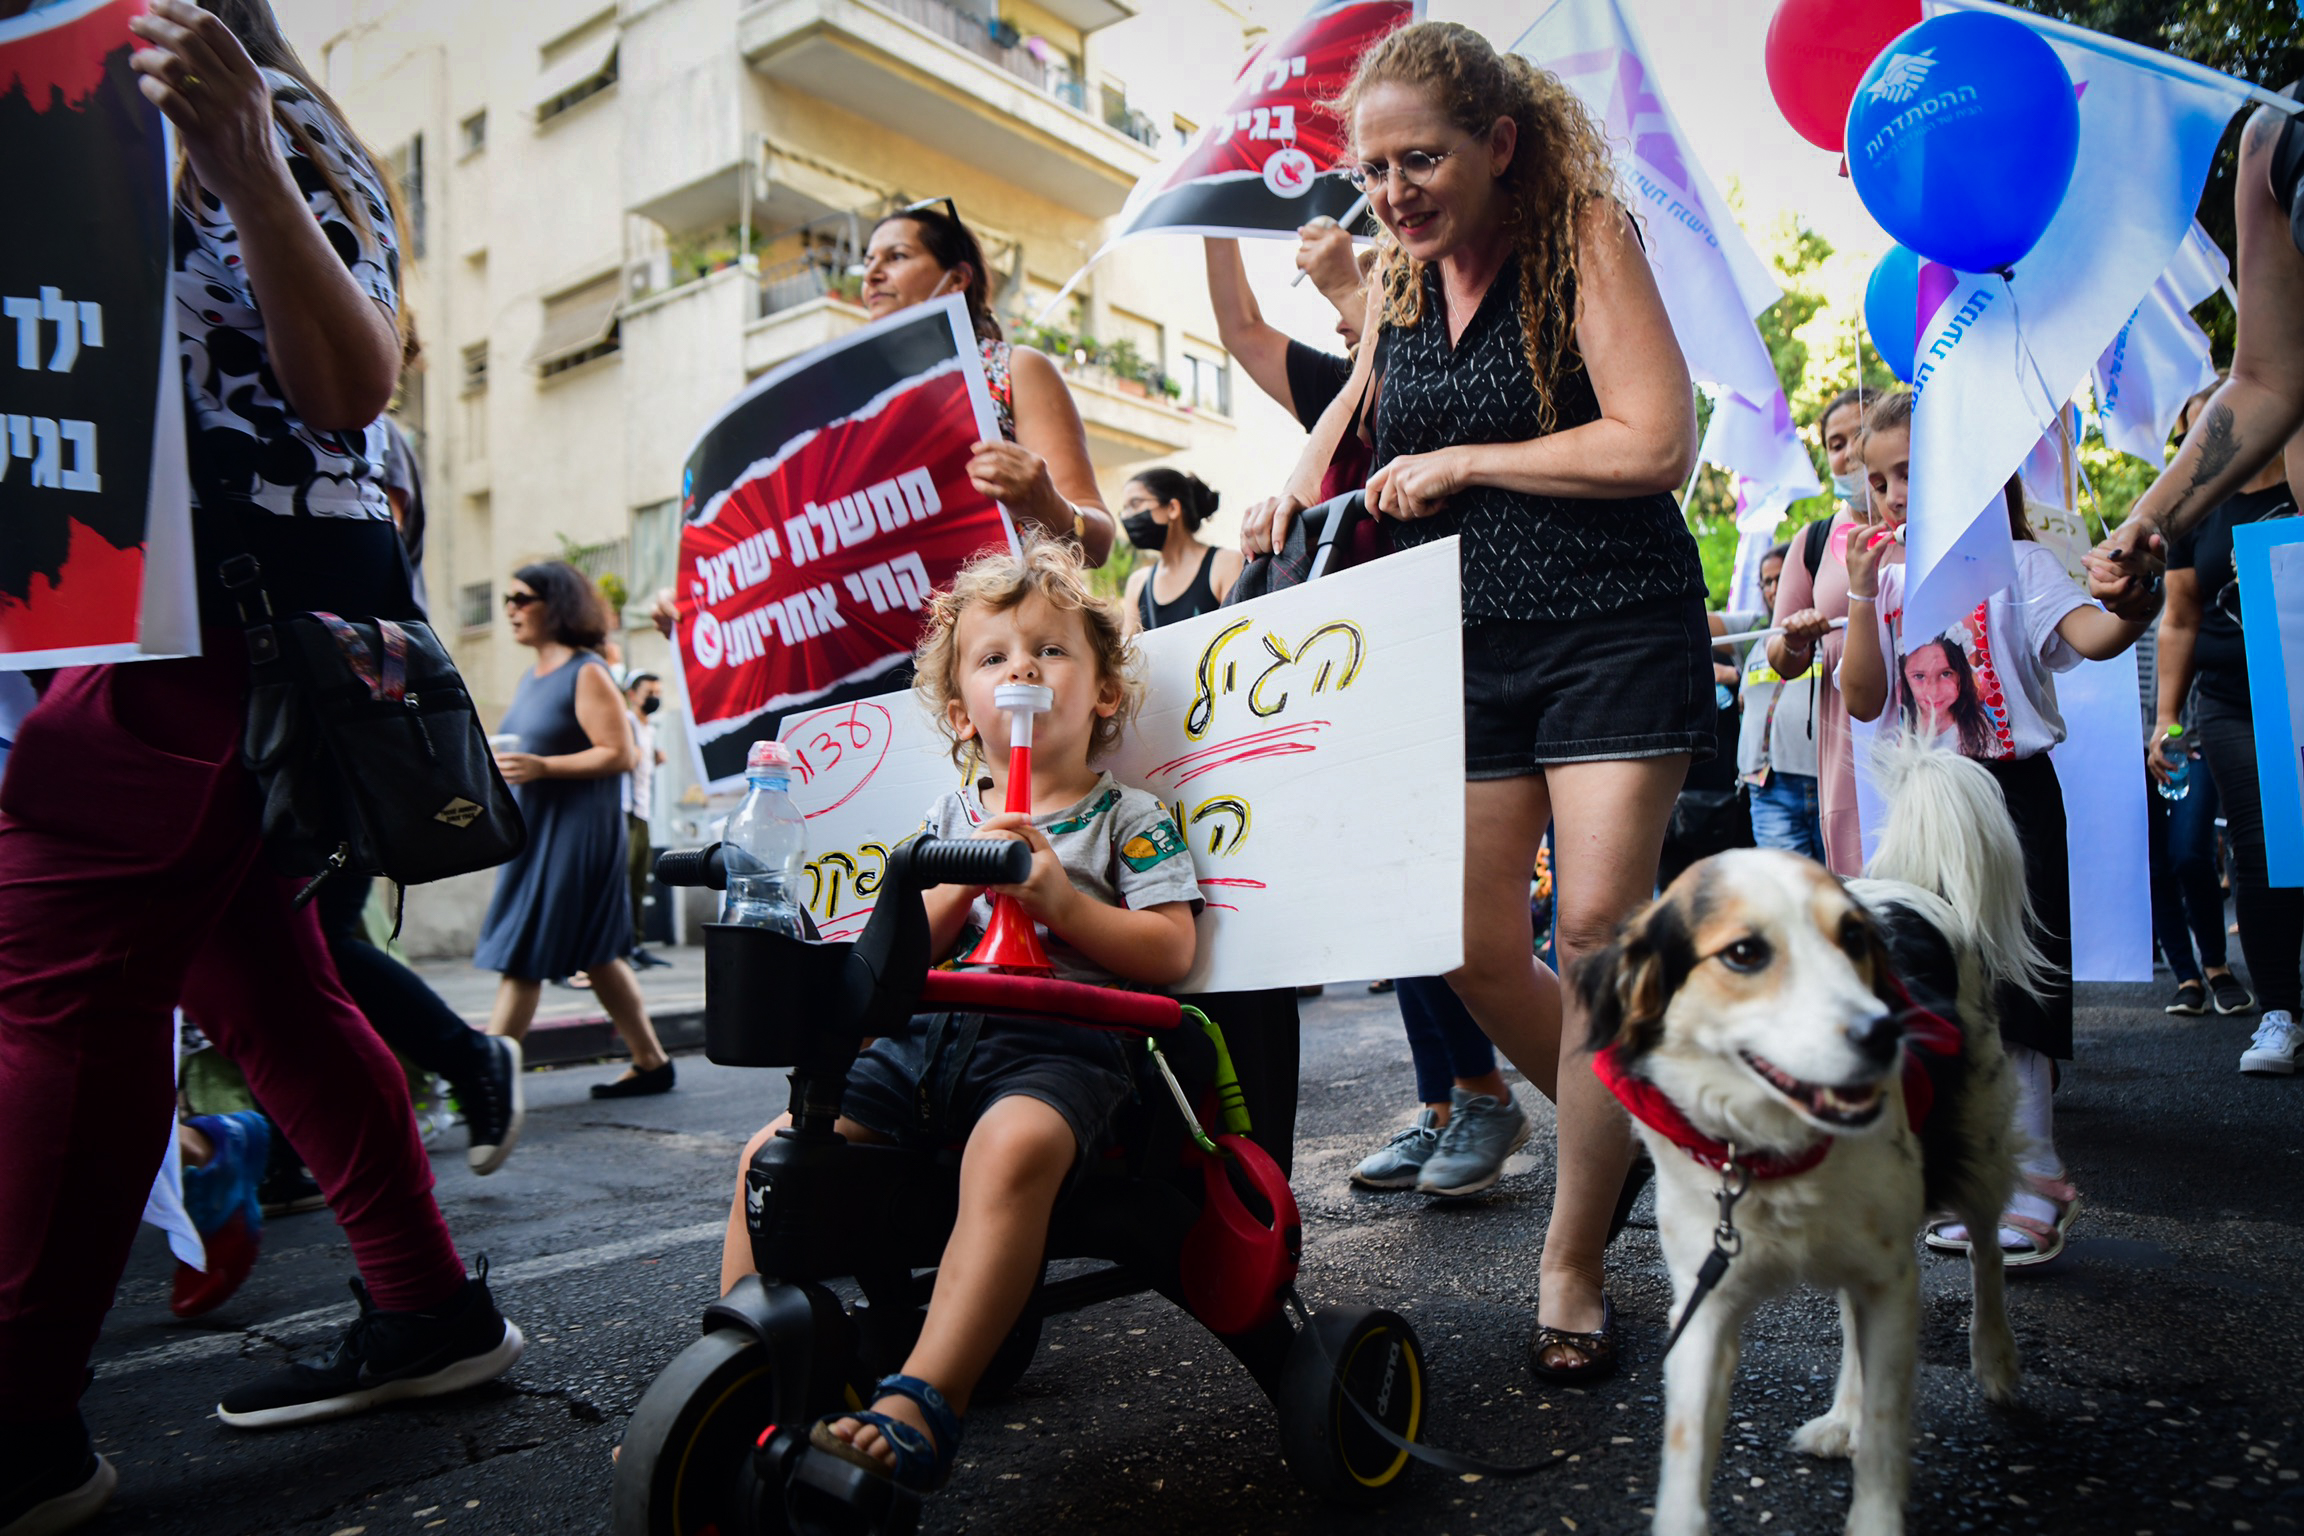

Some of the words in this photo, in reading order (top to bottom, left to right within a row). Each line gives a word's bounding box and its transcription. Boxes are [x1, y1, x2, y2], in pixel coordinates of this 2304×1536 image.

[1865, 85, 1977, 160] ההסתדרות
[1928, 289, 1995, 361] תנועת
[783, 465, 943, 568] ממשלת
[843, 550, 932, 615] קחי
[720, 582, 848, 669] אחריות!
[1183, 615, 1368, 743] הגיל
[1377, 1341, 1401, 1418] doona
